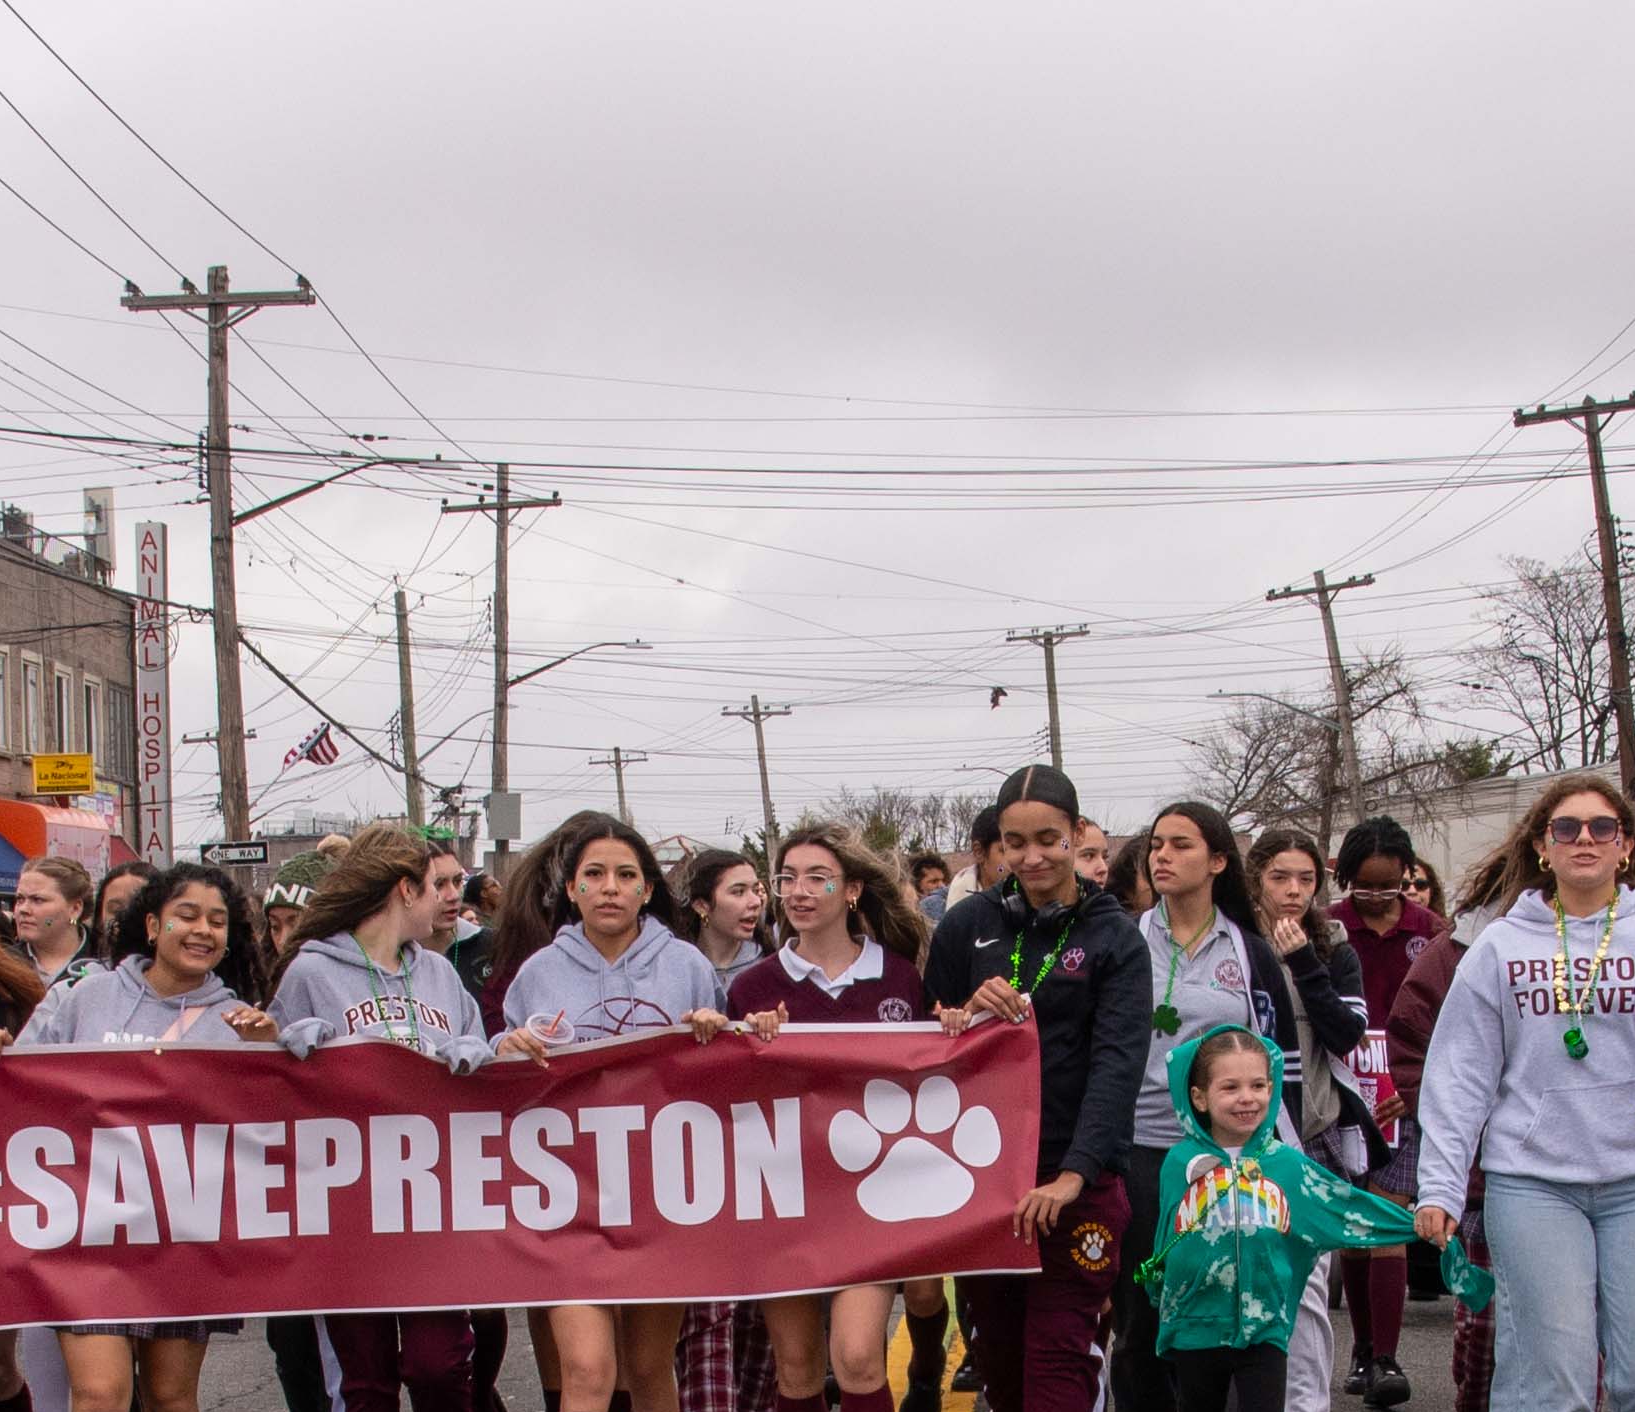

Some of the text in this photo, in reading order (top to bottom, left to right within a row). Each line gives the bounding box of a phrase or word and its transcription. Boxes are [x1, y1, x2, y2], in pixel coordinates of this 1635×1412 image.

[141, 531, 161, 669] ANIMAL
[51, 772, 87, 780] Nacional
[211, 848, 260, 860] ONE WAY
[344, 996, 452, 1036] PRESTON
